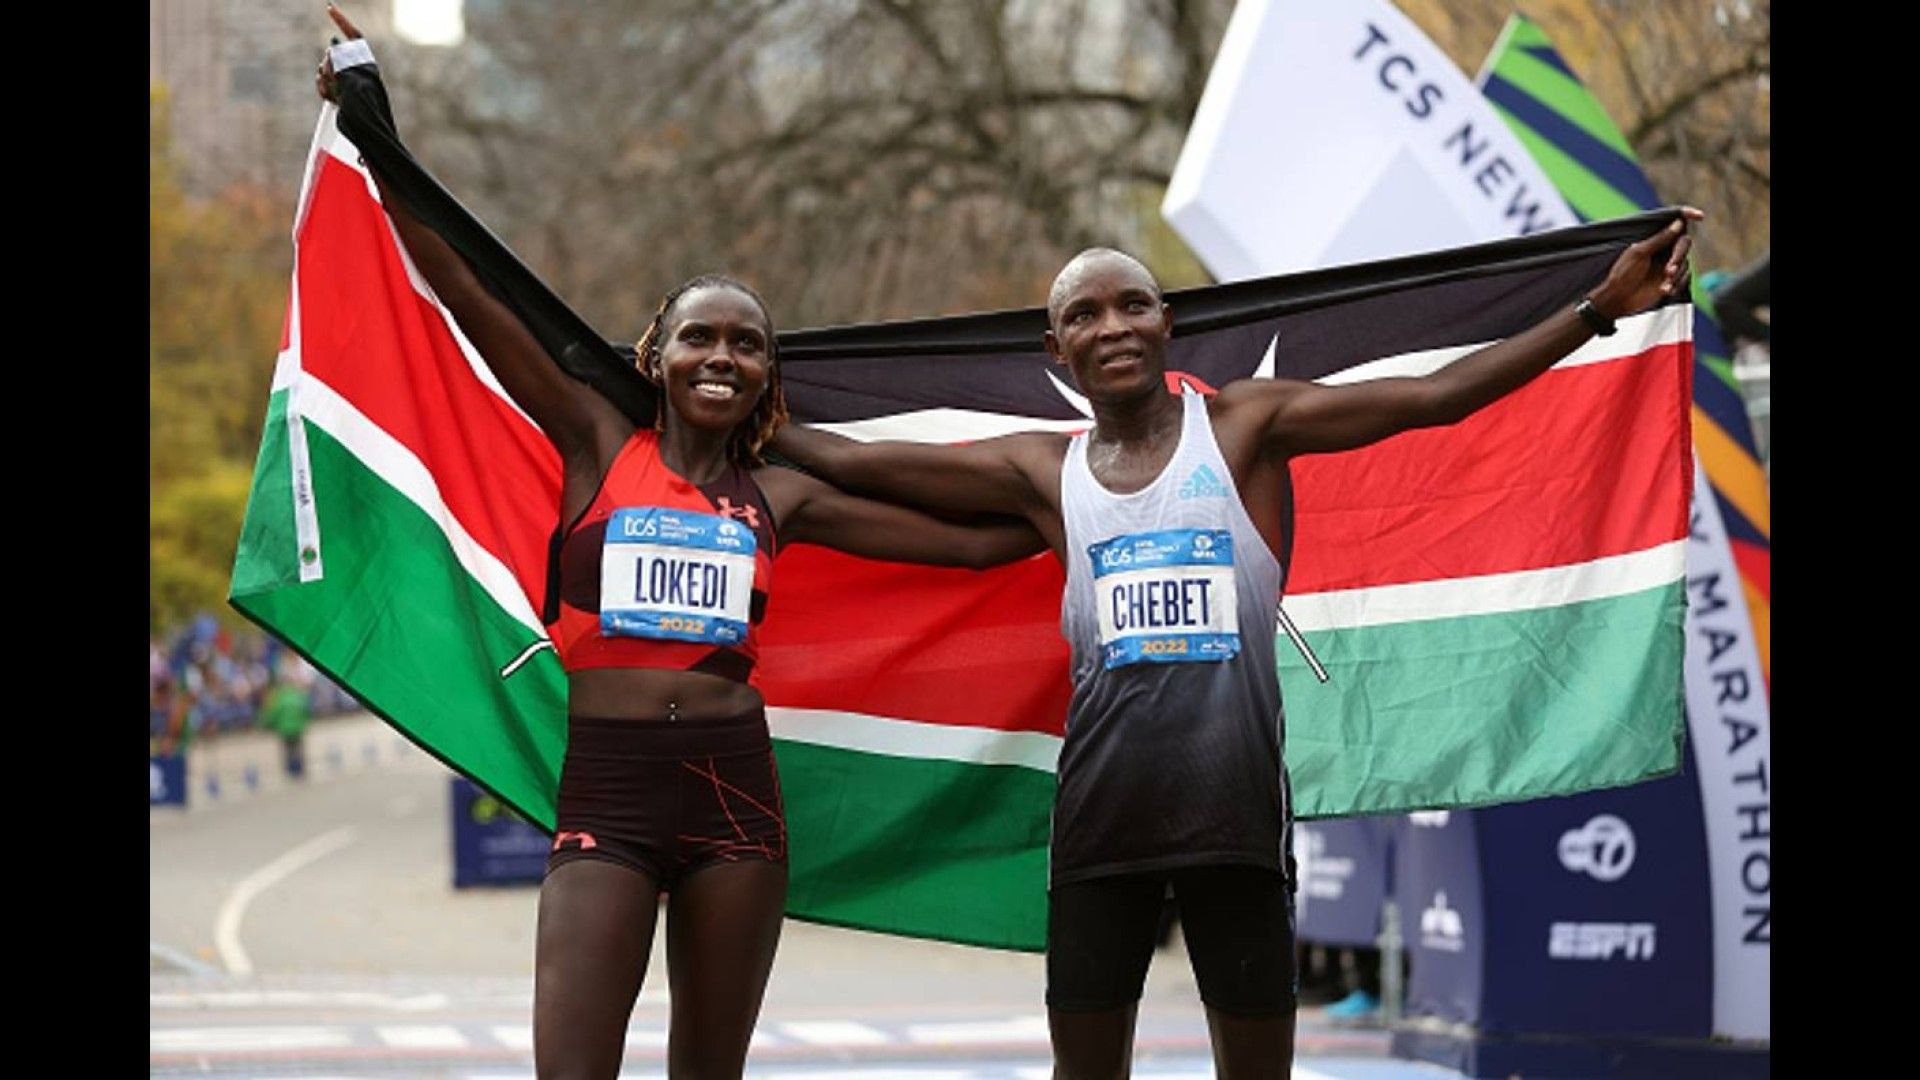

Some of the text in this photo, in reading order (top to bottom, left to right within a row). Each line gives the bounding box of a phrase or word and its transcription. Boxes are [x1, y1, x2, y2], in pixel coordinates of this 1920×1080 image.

[1352, 23, 1554, 234] TCS NEW
[634, 556, 728, 609] LOKEDI
[1112, 578, 1212, 631] CHEBET
[659, 616, 705, 634] 2022
[1141, 639, 1189, 655] 2022
[1688, 573, 1770, 945] MARATHON
[1549, 923, 1656, 959] ESPN
